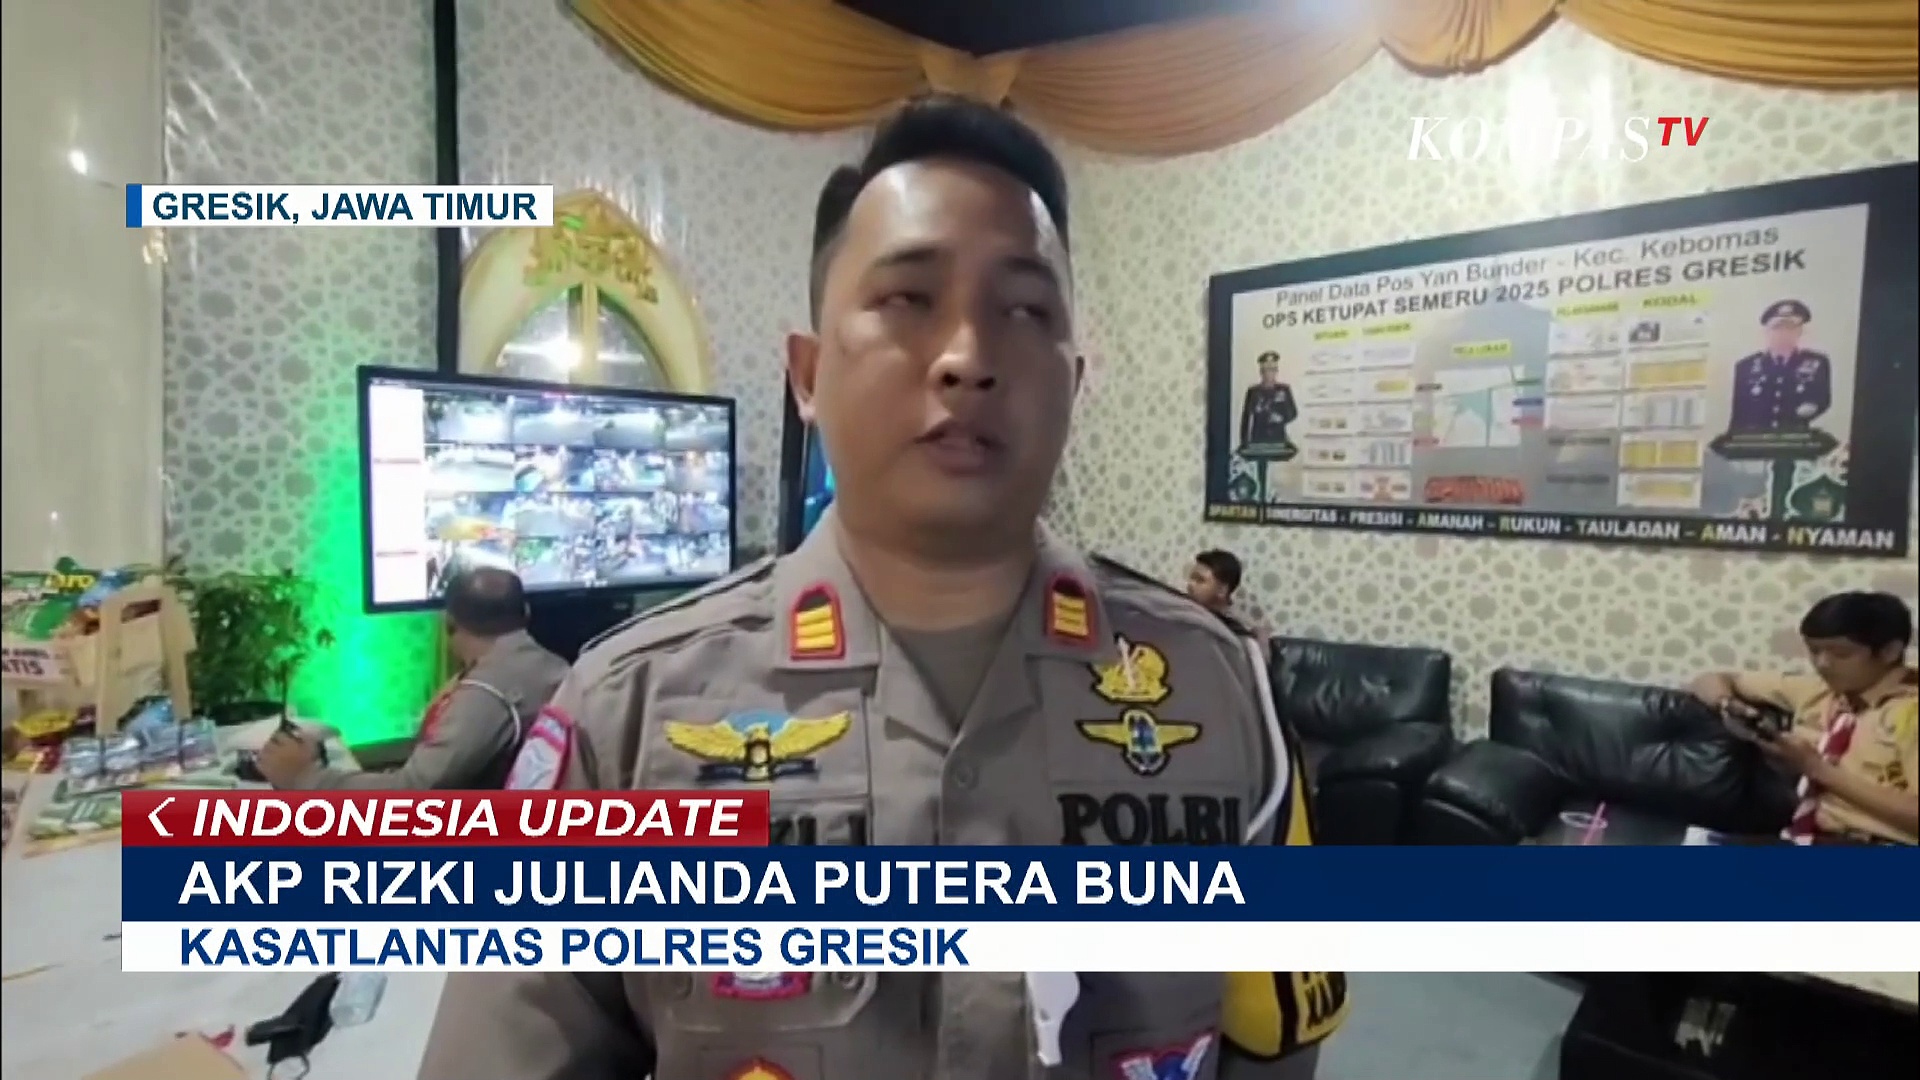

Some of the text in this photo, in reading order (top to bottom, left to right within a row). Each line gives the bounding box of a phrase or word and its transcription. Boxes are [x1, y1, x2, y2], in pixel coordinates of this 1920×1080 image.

[1262, 248, 1807, 330] OPS KETUPAT SEMERU 2025 POLRES GRESIK
[1276, 289, 1323, 306] Panel
[1329, 283, 1371, 300] Data
[1377, 276, 1413, 292] Pos
[1420, 269, 1459, 287] Yan
[1466, 257, 1549, 281] Bunder
[1641, 226, 1780, 260] Kebomas
[1350, 511, 1404, 527] PRESISI
[1416, 513, 1484, 531] AMANAH
[1500, 515, 1561, 535] RUKUN
[1576, 519, 1681, 540] TAULADAN
[1701, 523, 1767, 544] AMAN
[1787, 527, 1894, 549] NYAMAN
[1057, 793, 1241, 846] POLRI
